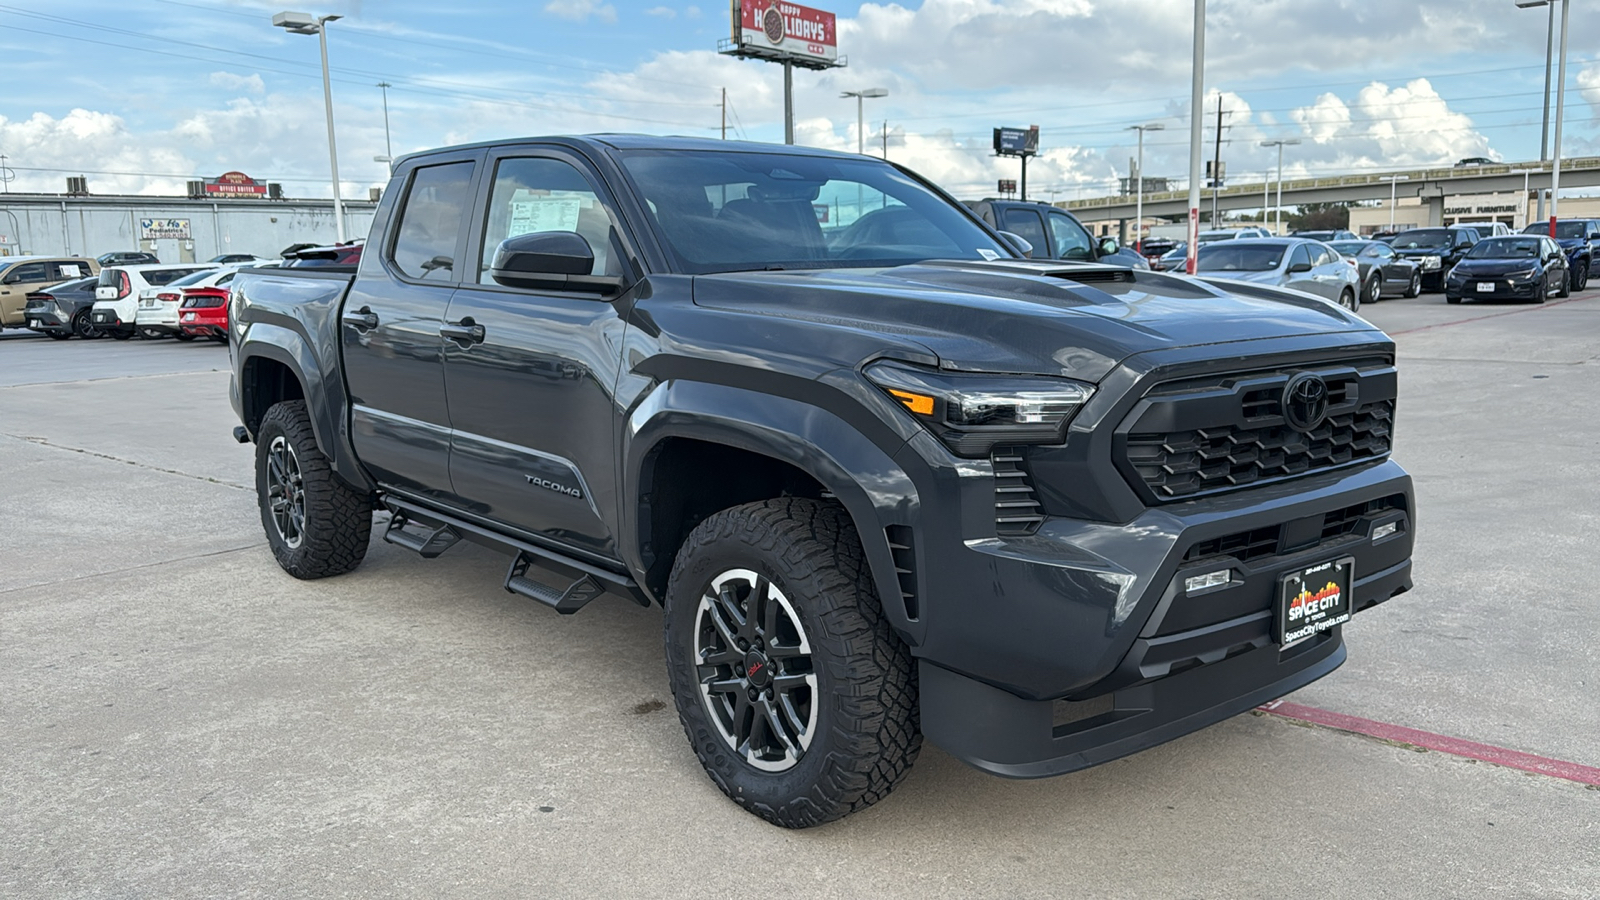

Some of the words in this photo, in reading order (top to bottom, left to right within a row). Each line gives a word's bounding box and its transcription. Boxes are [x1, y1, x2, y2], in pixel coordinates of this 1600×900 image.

[780, 5, 800, 16] HAPPY
[754, 9, 824, 41] HOLIDAYS
[1443, 206, 1472, 214] CLUSIVE
[1476, 204, 1517, 214] FURNITURE
[524, 474, 581, 498] TACOMA
[1288, 599, 1318, 621] SPACE
[1320, 592, 1340, 610] CITY
[1311, 612, 1326, 621] TOYOTA
[1285, 613, 1349, 642] SpaceCityToyota.com
